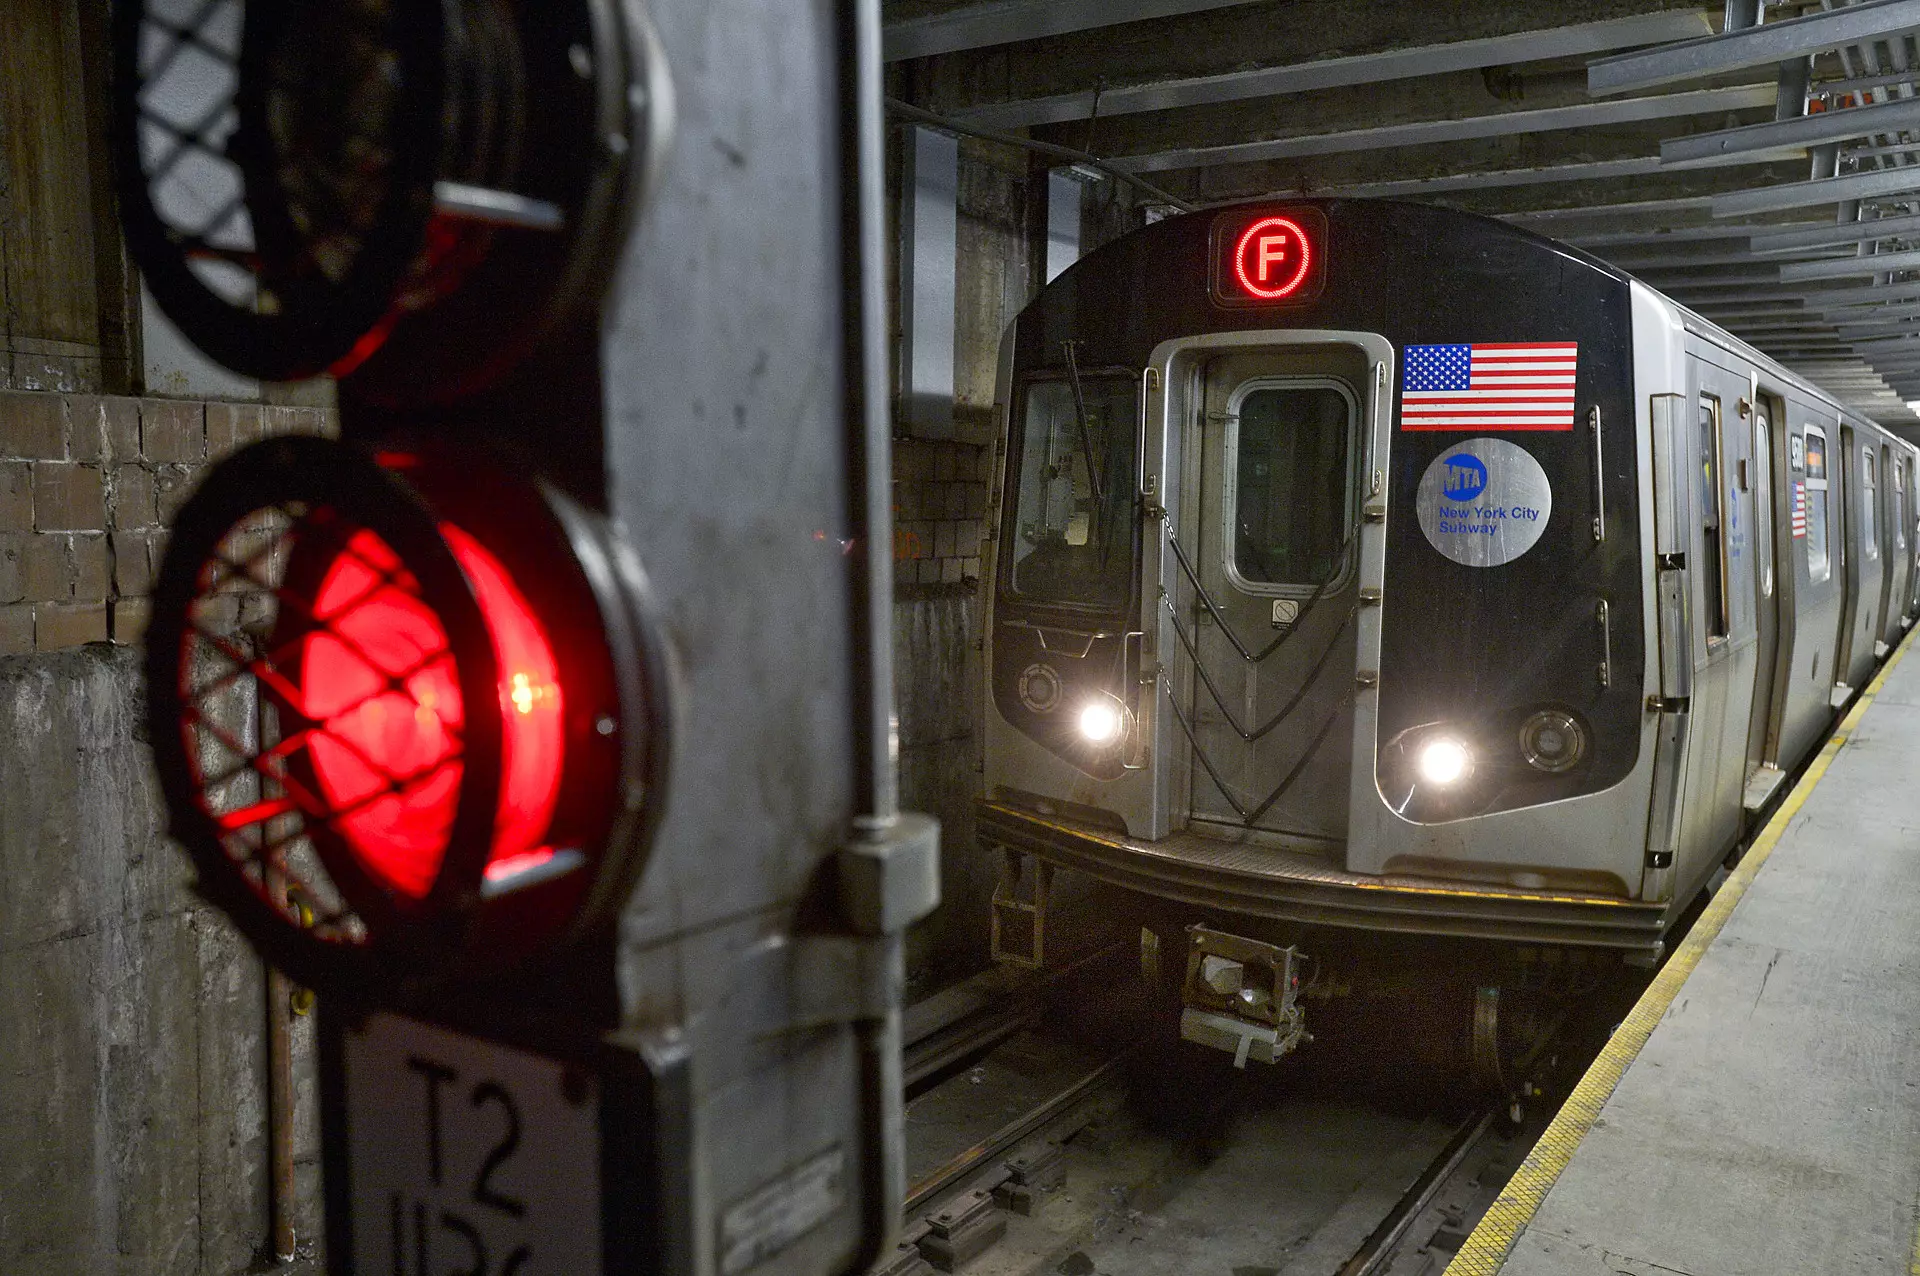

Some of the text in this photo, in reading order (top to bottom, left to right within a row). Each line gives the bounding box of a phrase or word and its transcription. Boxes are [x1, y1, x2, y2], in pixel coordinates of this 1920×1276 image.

[1259, 235, 1286, 281] F
[1443, 463, 1481, 492] MTA
[1440, 506, 1540, 521] New York City
[1440, 521, 1498, 536] Subway
